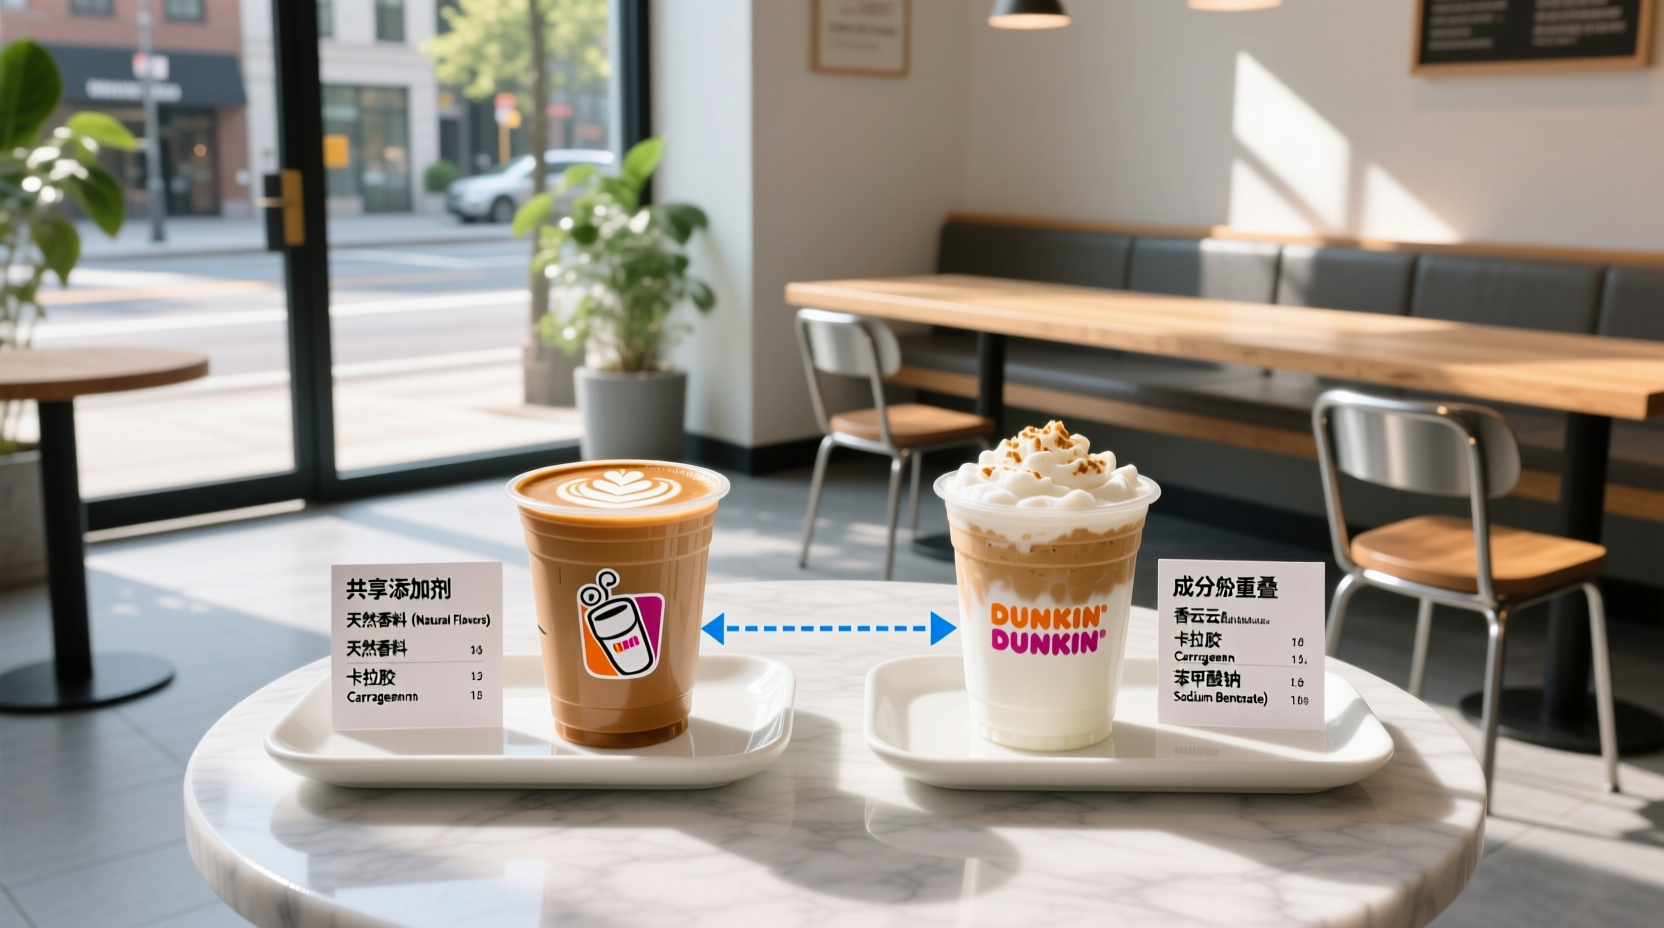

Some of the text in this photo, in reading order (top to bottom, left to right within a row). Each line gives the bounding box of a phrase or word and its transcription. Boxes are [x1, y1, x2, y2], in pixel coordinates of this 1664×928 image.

[346, 577, 452, 600] 共享添加剂
[347, 611, 407, 628] 天然香料
[991, 602, 1108, 630] DUNKIN'
[346, 639, 408, 658] 天然香料
[991, 628, 1106, 656] DUNKIN'
[346, 668, 397, 688] 卡拉胶
